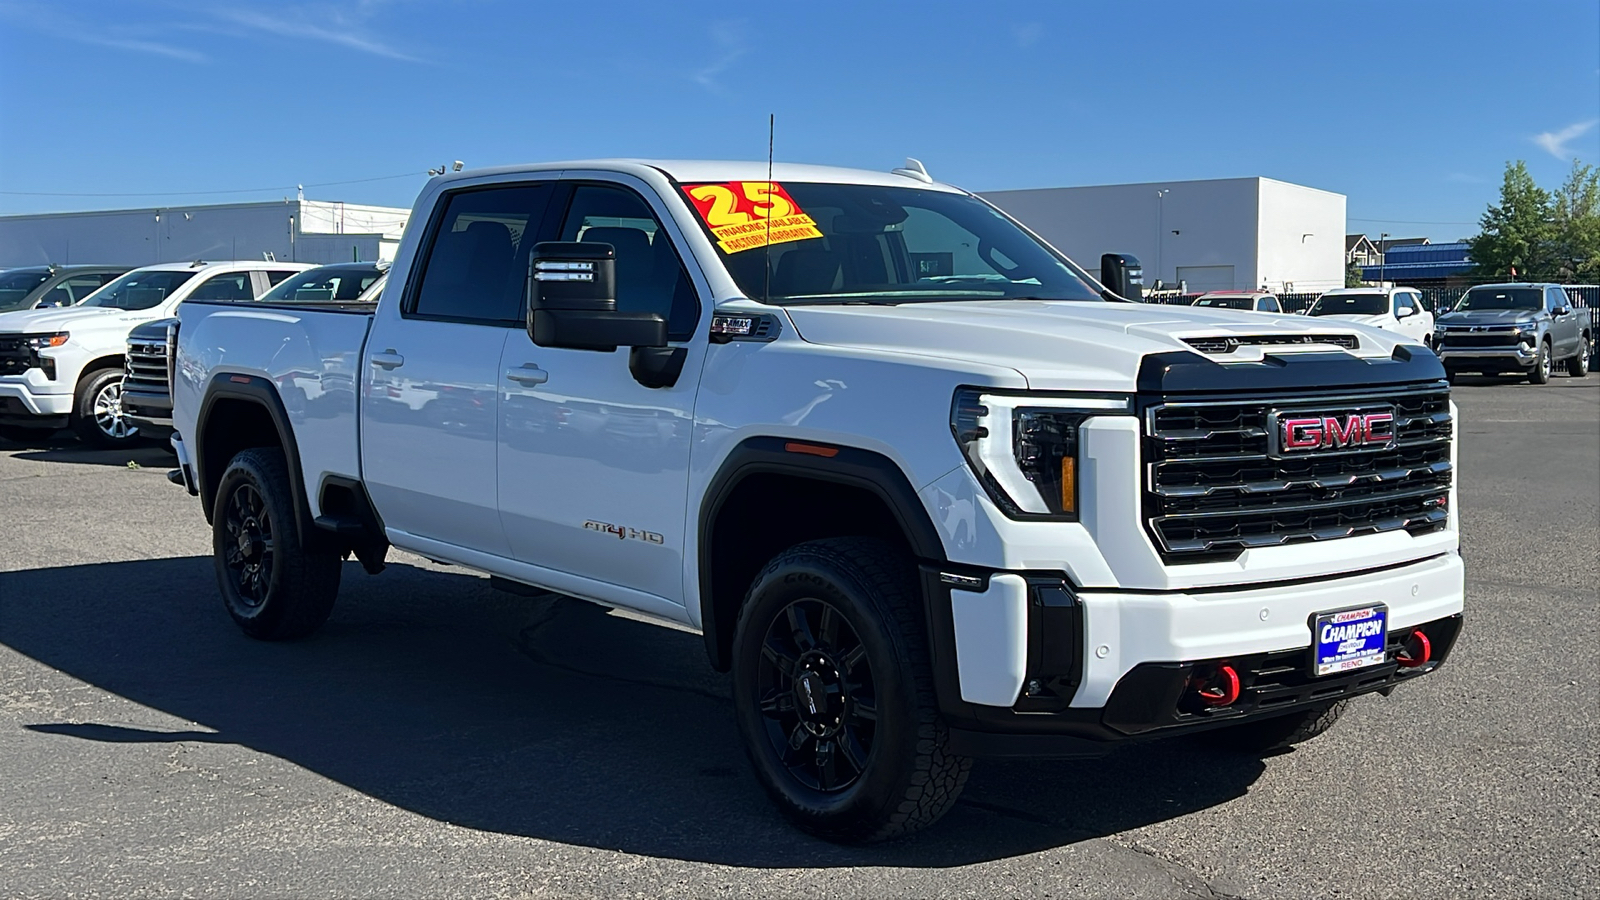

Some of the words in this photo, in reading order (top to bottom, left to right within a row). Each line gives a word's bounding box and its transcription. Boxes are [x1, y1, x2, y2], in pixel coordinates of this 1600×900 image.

[690, 182, 794, 226] 25
[716, 221, 765, 238] FINANCING
[764, 216, 812, 229] AVAILABLE
[724, 234, 765, 251] FACTORY
[765, 227, 815, 242] WARRANTY
[1283, 413, 1395, 450] GMC
[1336, 610, 1371, 623] CHAMPION
[1320, 620, 1383, 644] CHAMPION
[1341, 659, 1363, 669] RENO
